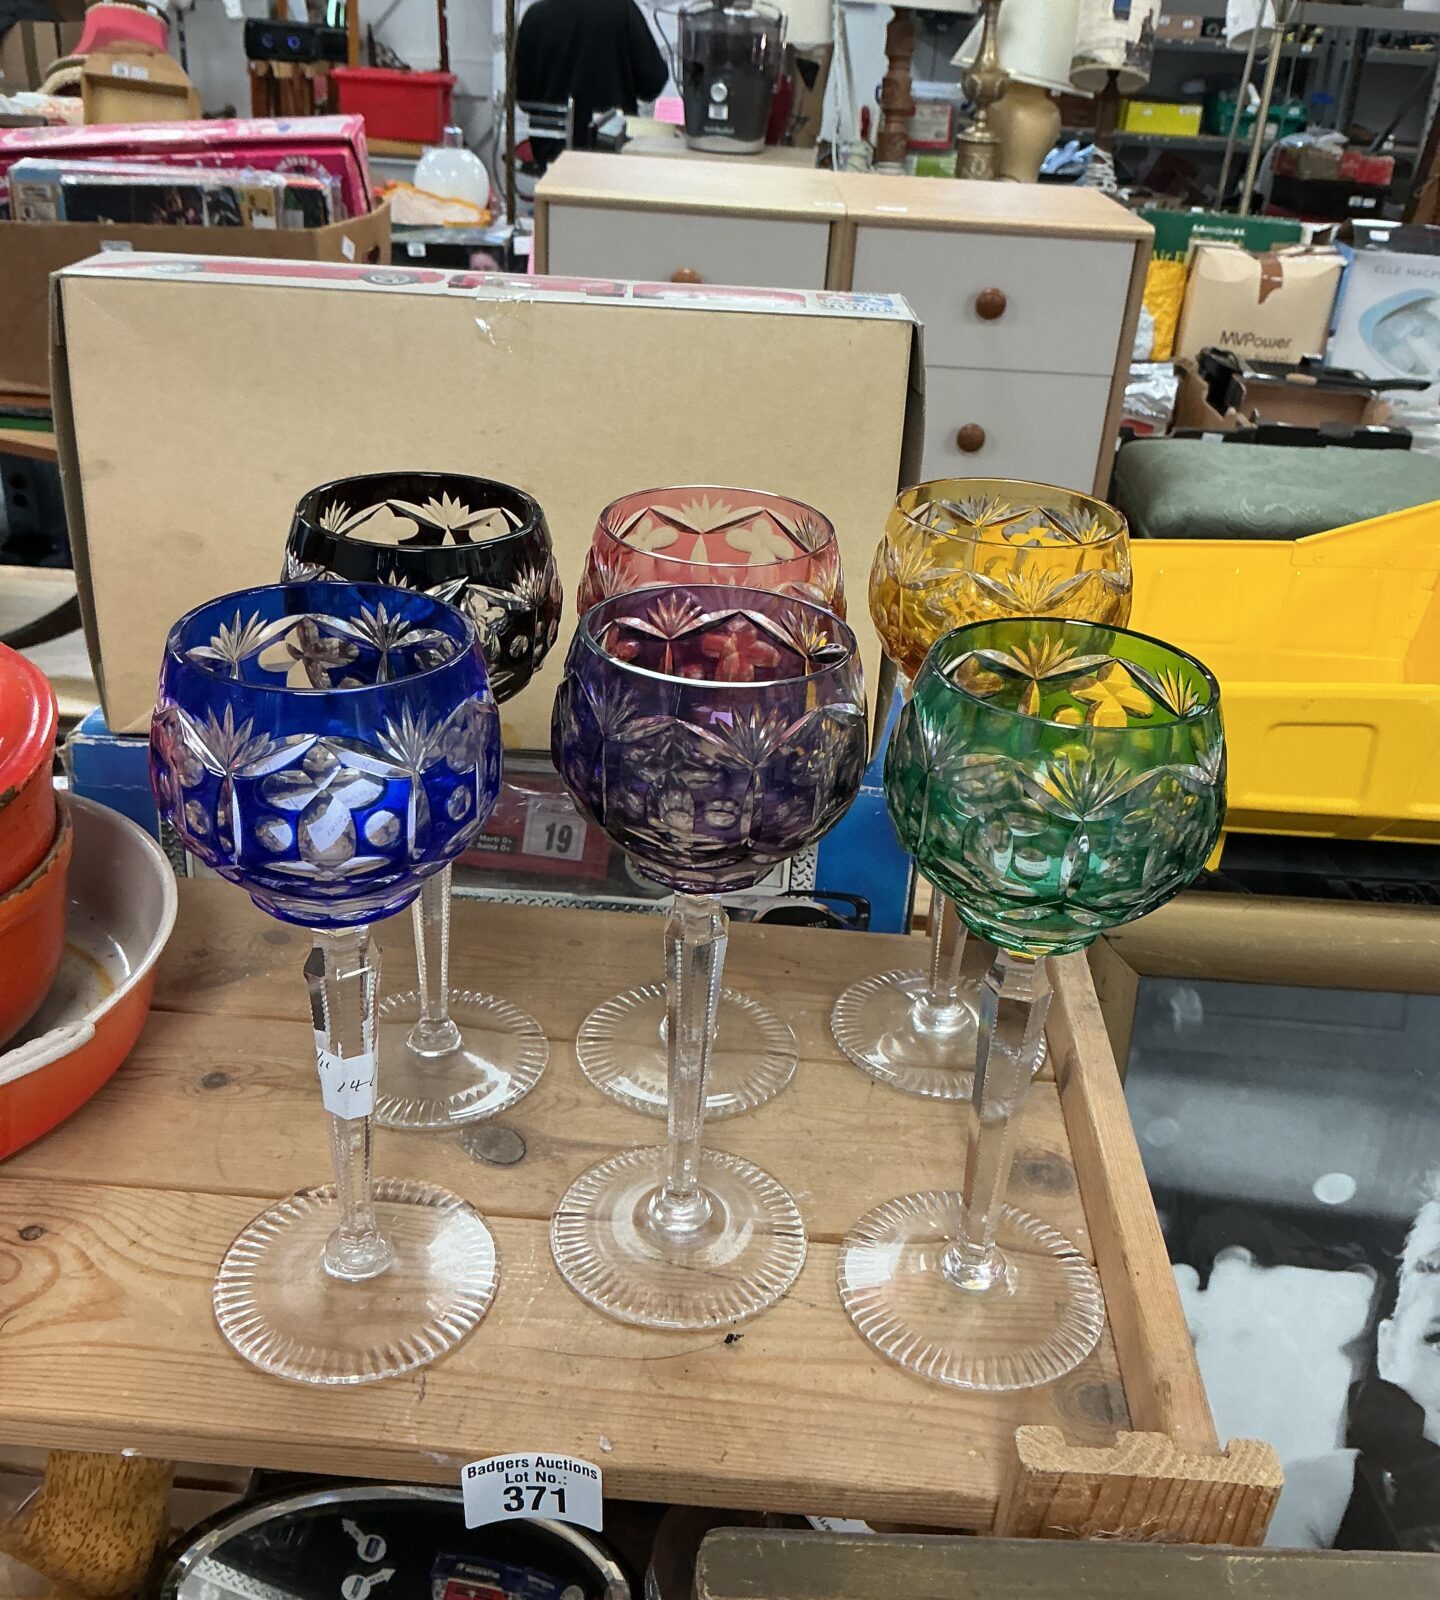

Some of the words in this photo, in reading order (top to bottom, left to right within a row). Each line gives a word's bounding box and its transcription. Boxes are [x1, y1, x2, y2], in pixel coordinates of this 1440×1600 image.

[1220, 330, 1294, 348] MVPower
[545, 822, 573, 853] 19
[467, 1458, 529, 1479] Badgers
[535, 1456, 598, 1480] Auctions
[505, 1471, 529, 1484] Lot
[536, 1471, 567, 1485] No.:
[503, 1486, 566, 1513] 371
